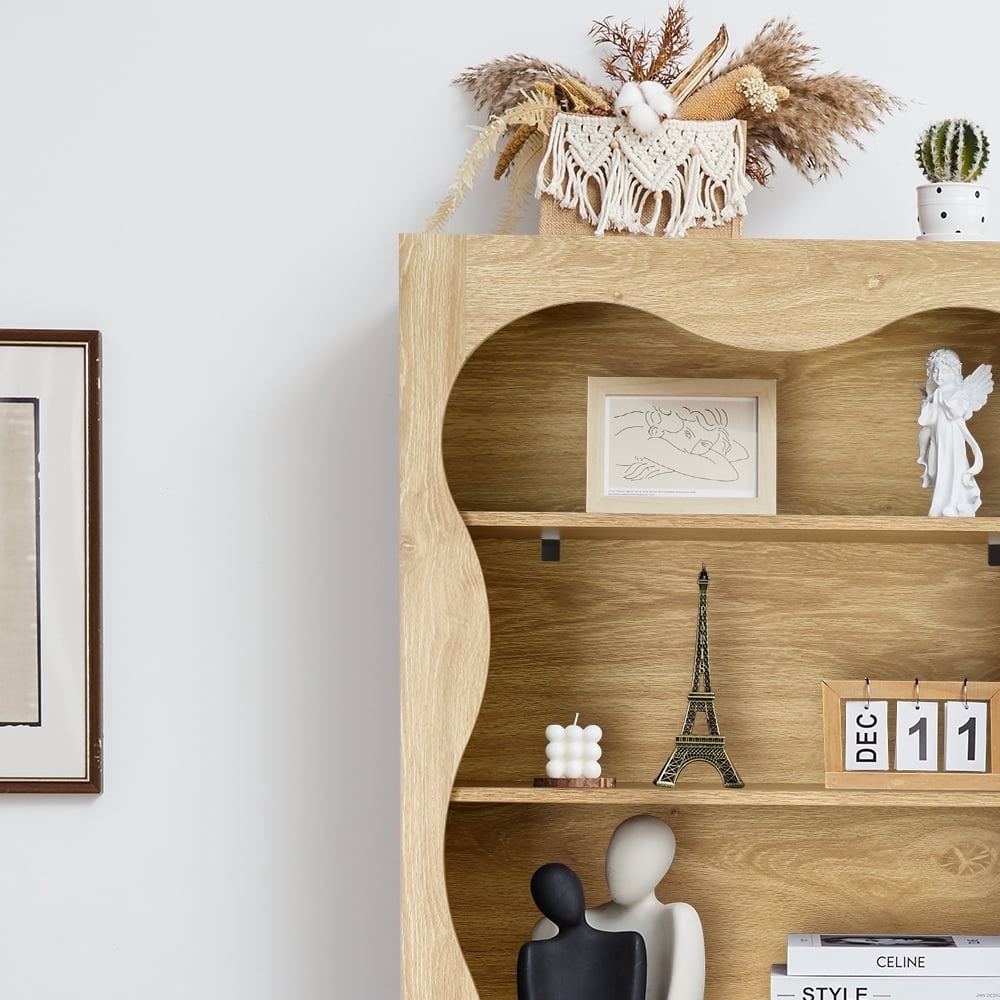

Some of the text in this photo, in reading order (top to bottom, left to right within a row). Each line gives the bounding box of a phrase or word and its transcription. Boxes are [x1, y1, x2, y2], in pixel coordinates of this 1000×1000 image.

[855, 713, 878, 763] DEC
[908, 716, 977, 761] 1 1
[876, 955, 926, 969] CELINE
